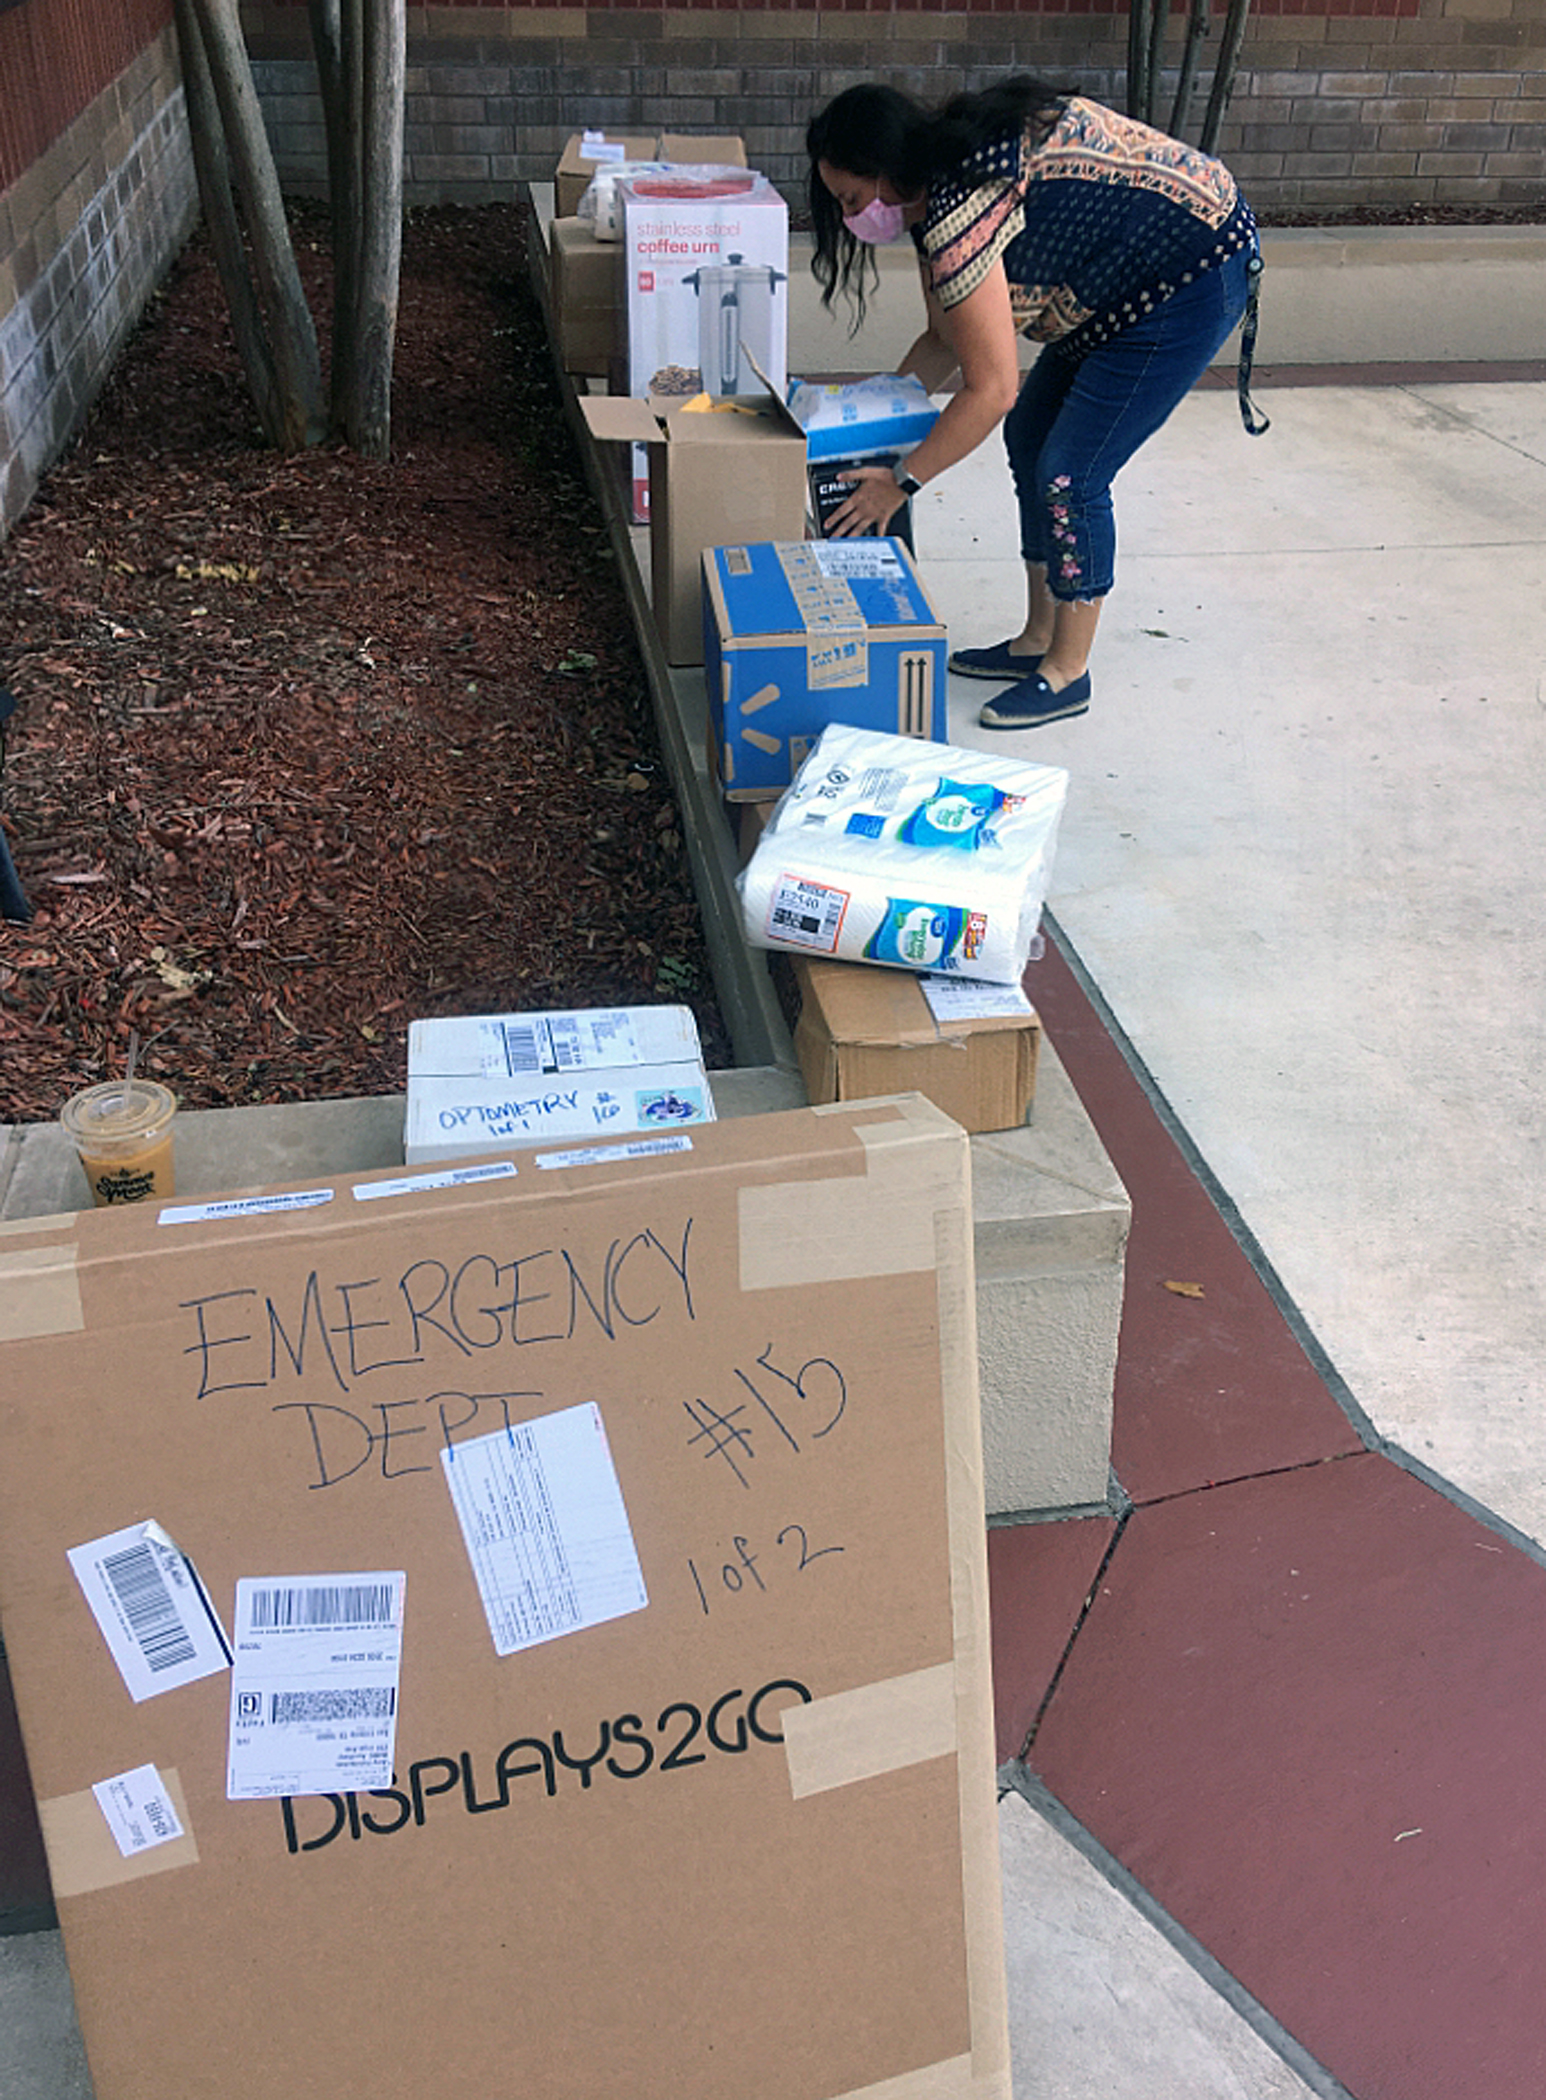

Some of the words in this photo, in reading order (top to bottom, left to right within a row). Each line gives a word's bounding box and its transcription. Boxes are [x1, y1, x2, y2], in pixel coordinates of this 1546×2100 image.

[637, 220, 702, 237] stainless
[705, 220, 741, 237] steel
[637, 238, 689, 254] coffee
[691, 242, 719, 254] urn
[438, 1089, 578, 1130] OPTOMETRY
[178, 1217, 696, 1400] EMERGENCY
[271, 1390, 544, 1490] DEPT
[682, 1342, 847, 1490] #15
[687, 1558, 709, 1615] 1
[722, 1535, 767, 1591] of
[776, 1524, 845, 1571] 2
